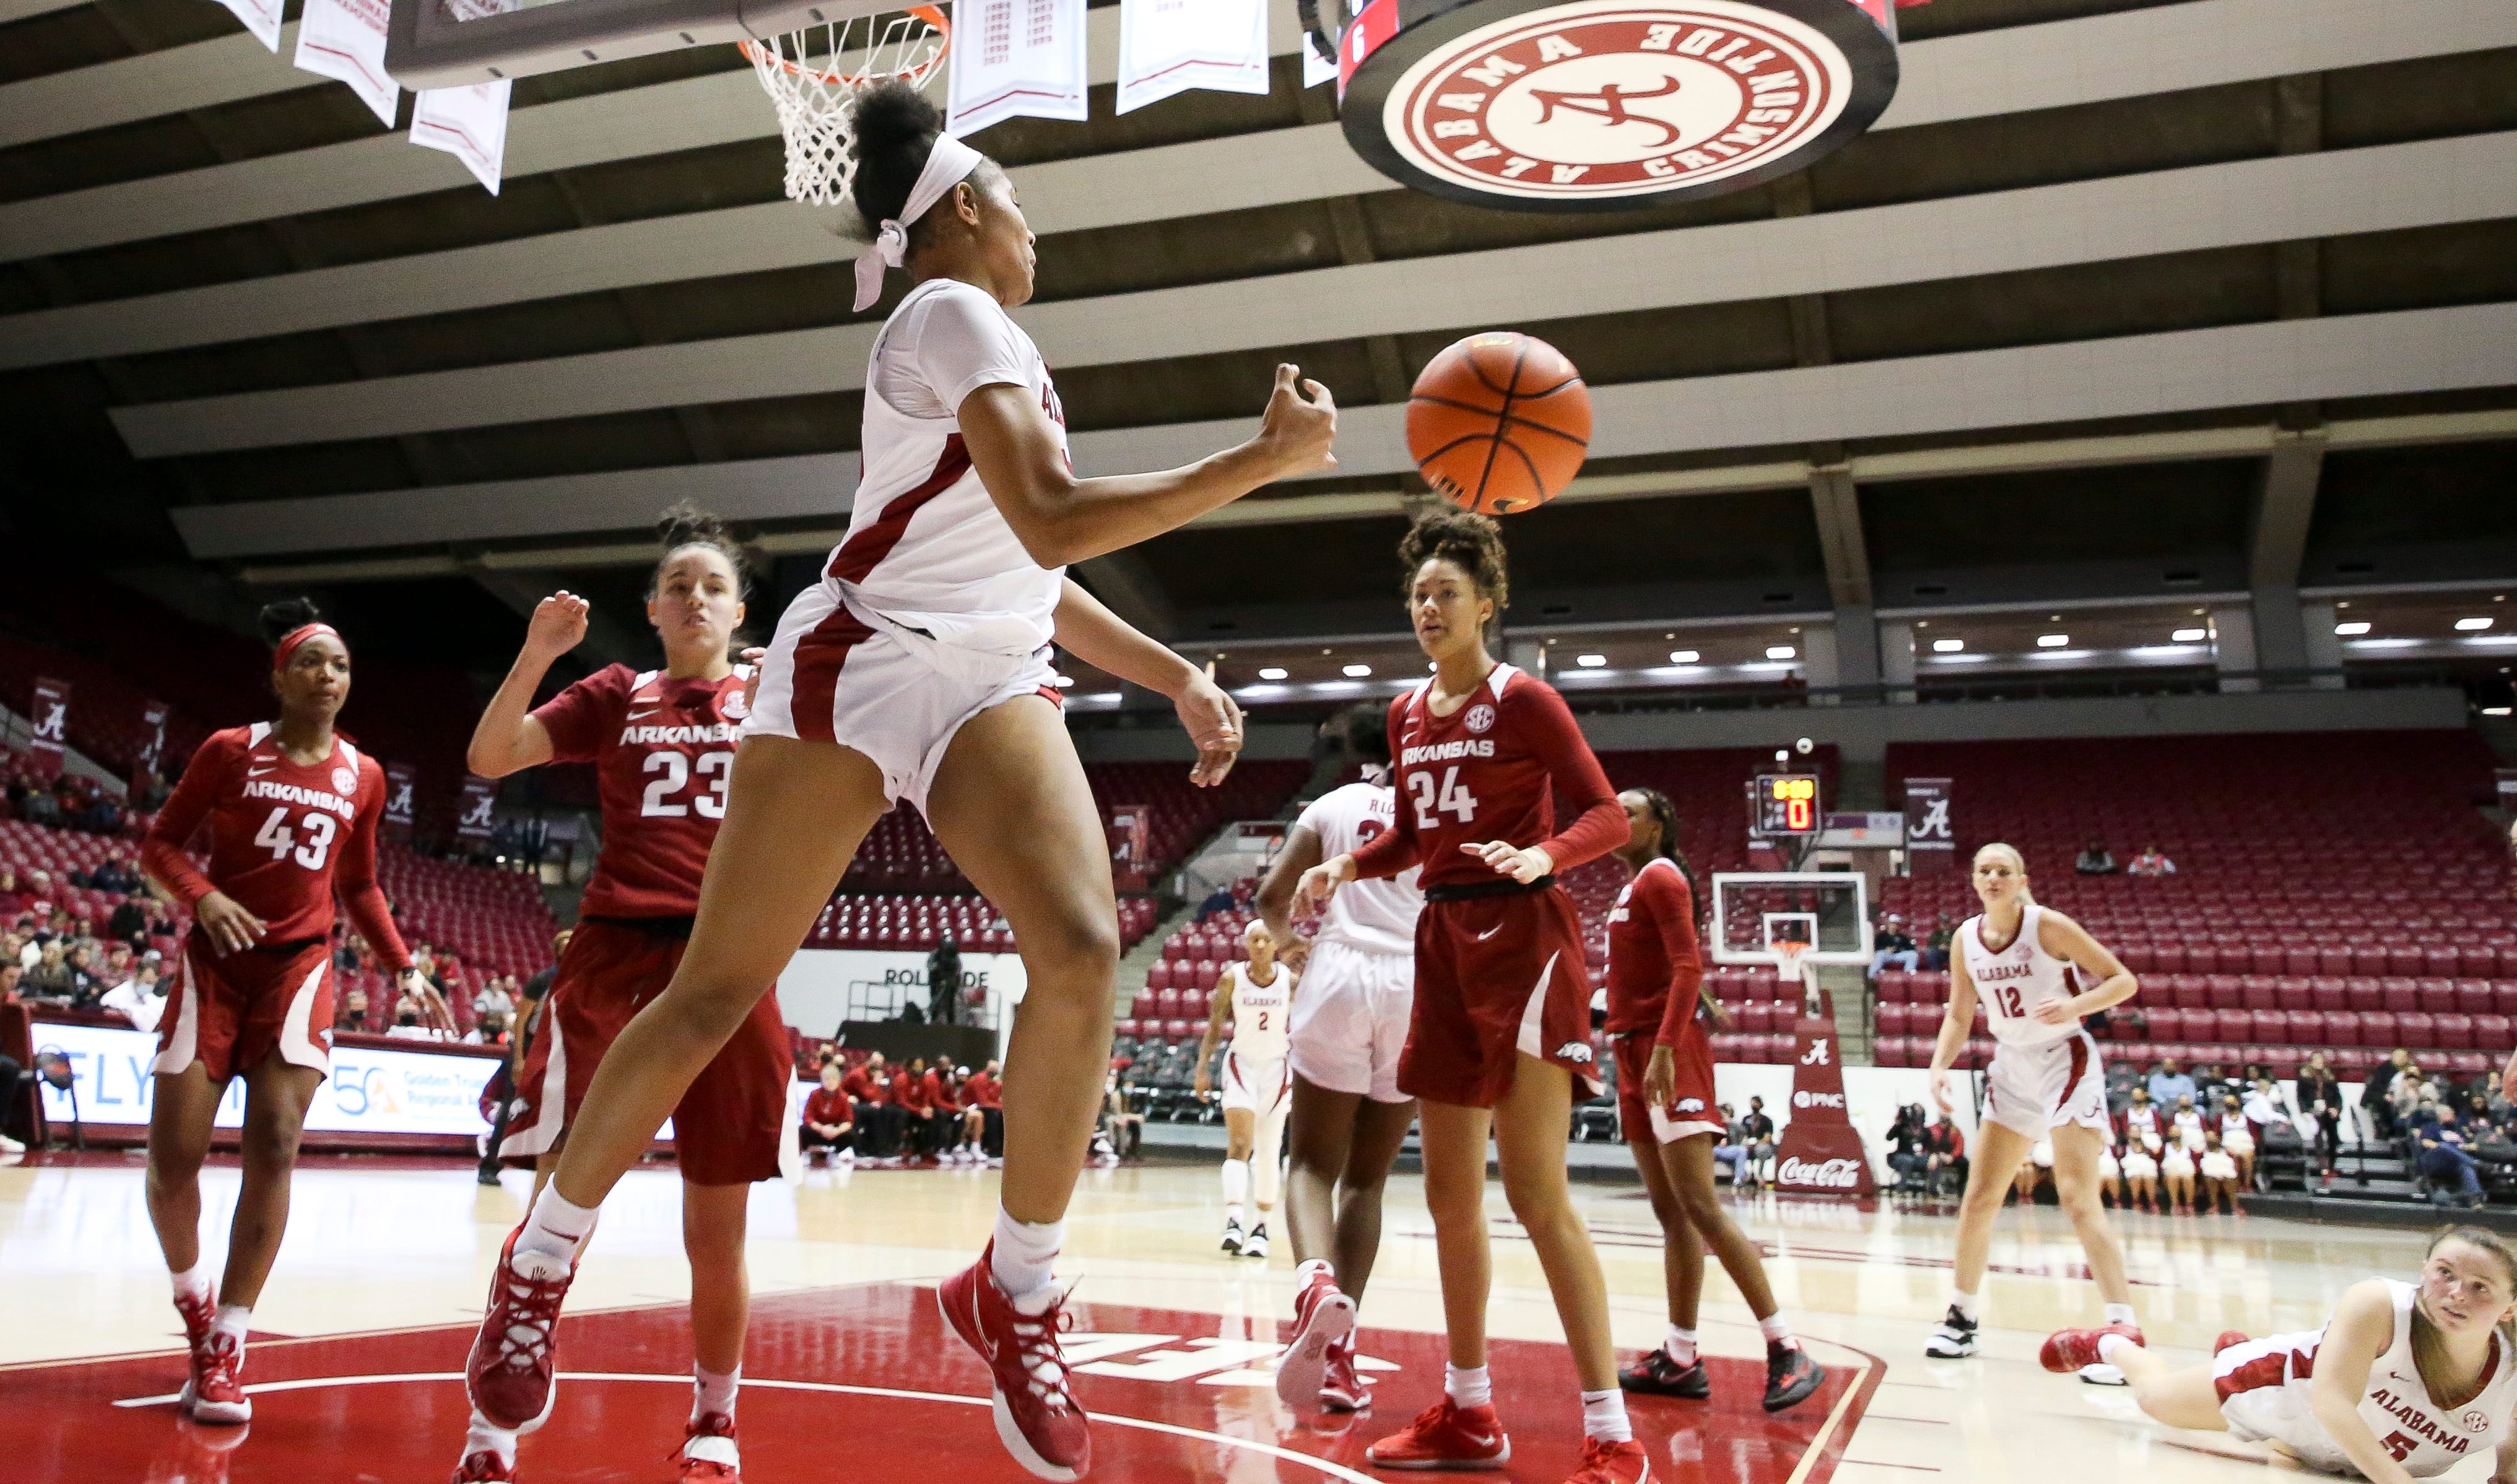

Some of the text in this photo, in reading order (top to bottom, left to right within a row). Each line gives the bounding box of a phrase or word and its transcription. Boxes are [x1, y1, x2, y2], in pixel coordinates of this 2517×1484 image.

[1640, 24, 1776, 74] TIDE
[1432, 35, 1590, 184] ALABAMA
[1642, 69, 1801, 178] CRIMSON
[241, 781, 355, 820] ARKANSAS
[640, 750, 736, 819] 23
[1407, 766, 1479, 830] 24
[254, 807, 337, 870] 43
[1259, 1012, 1268, 1030] 2
[1994, 987, 2025, 1018] 12
[2370, 1387, 2470, 1454] ALABAMA
[2379, 1430, 2420, 1463] 5
